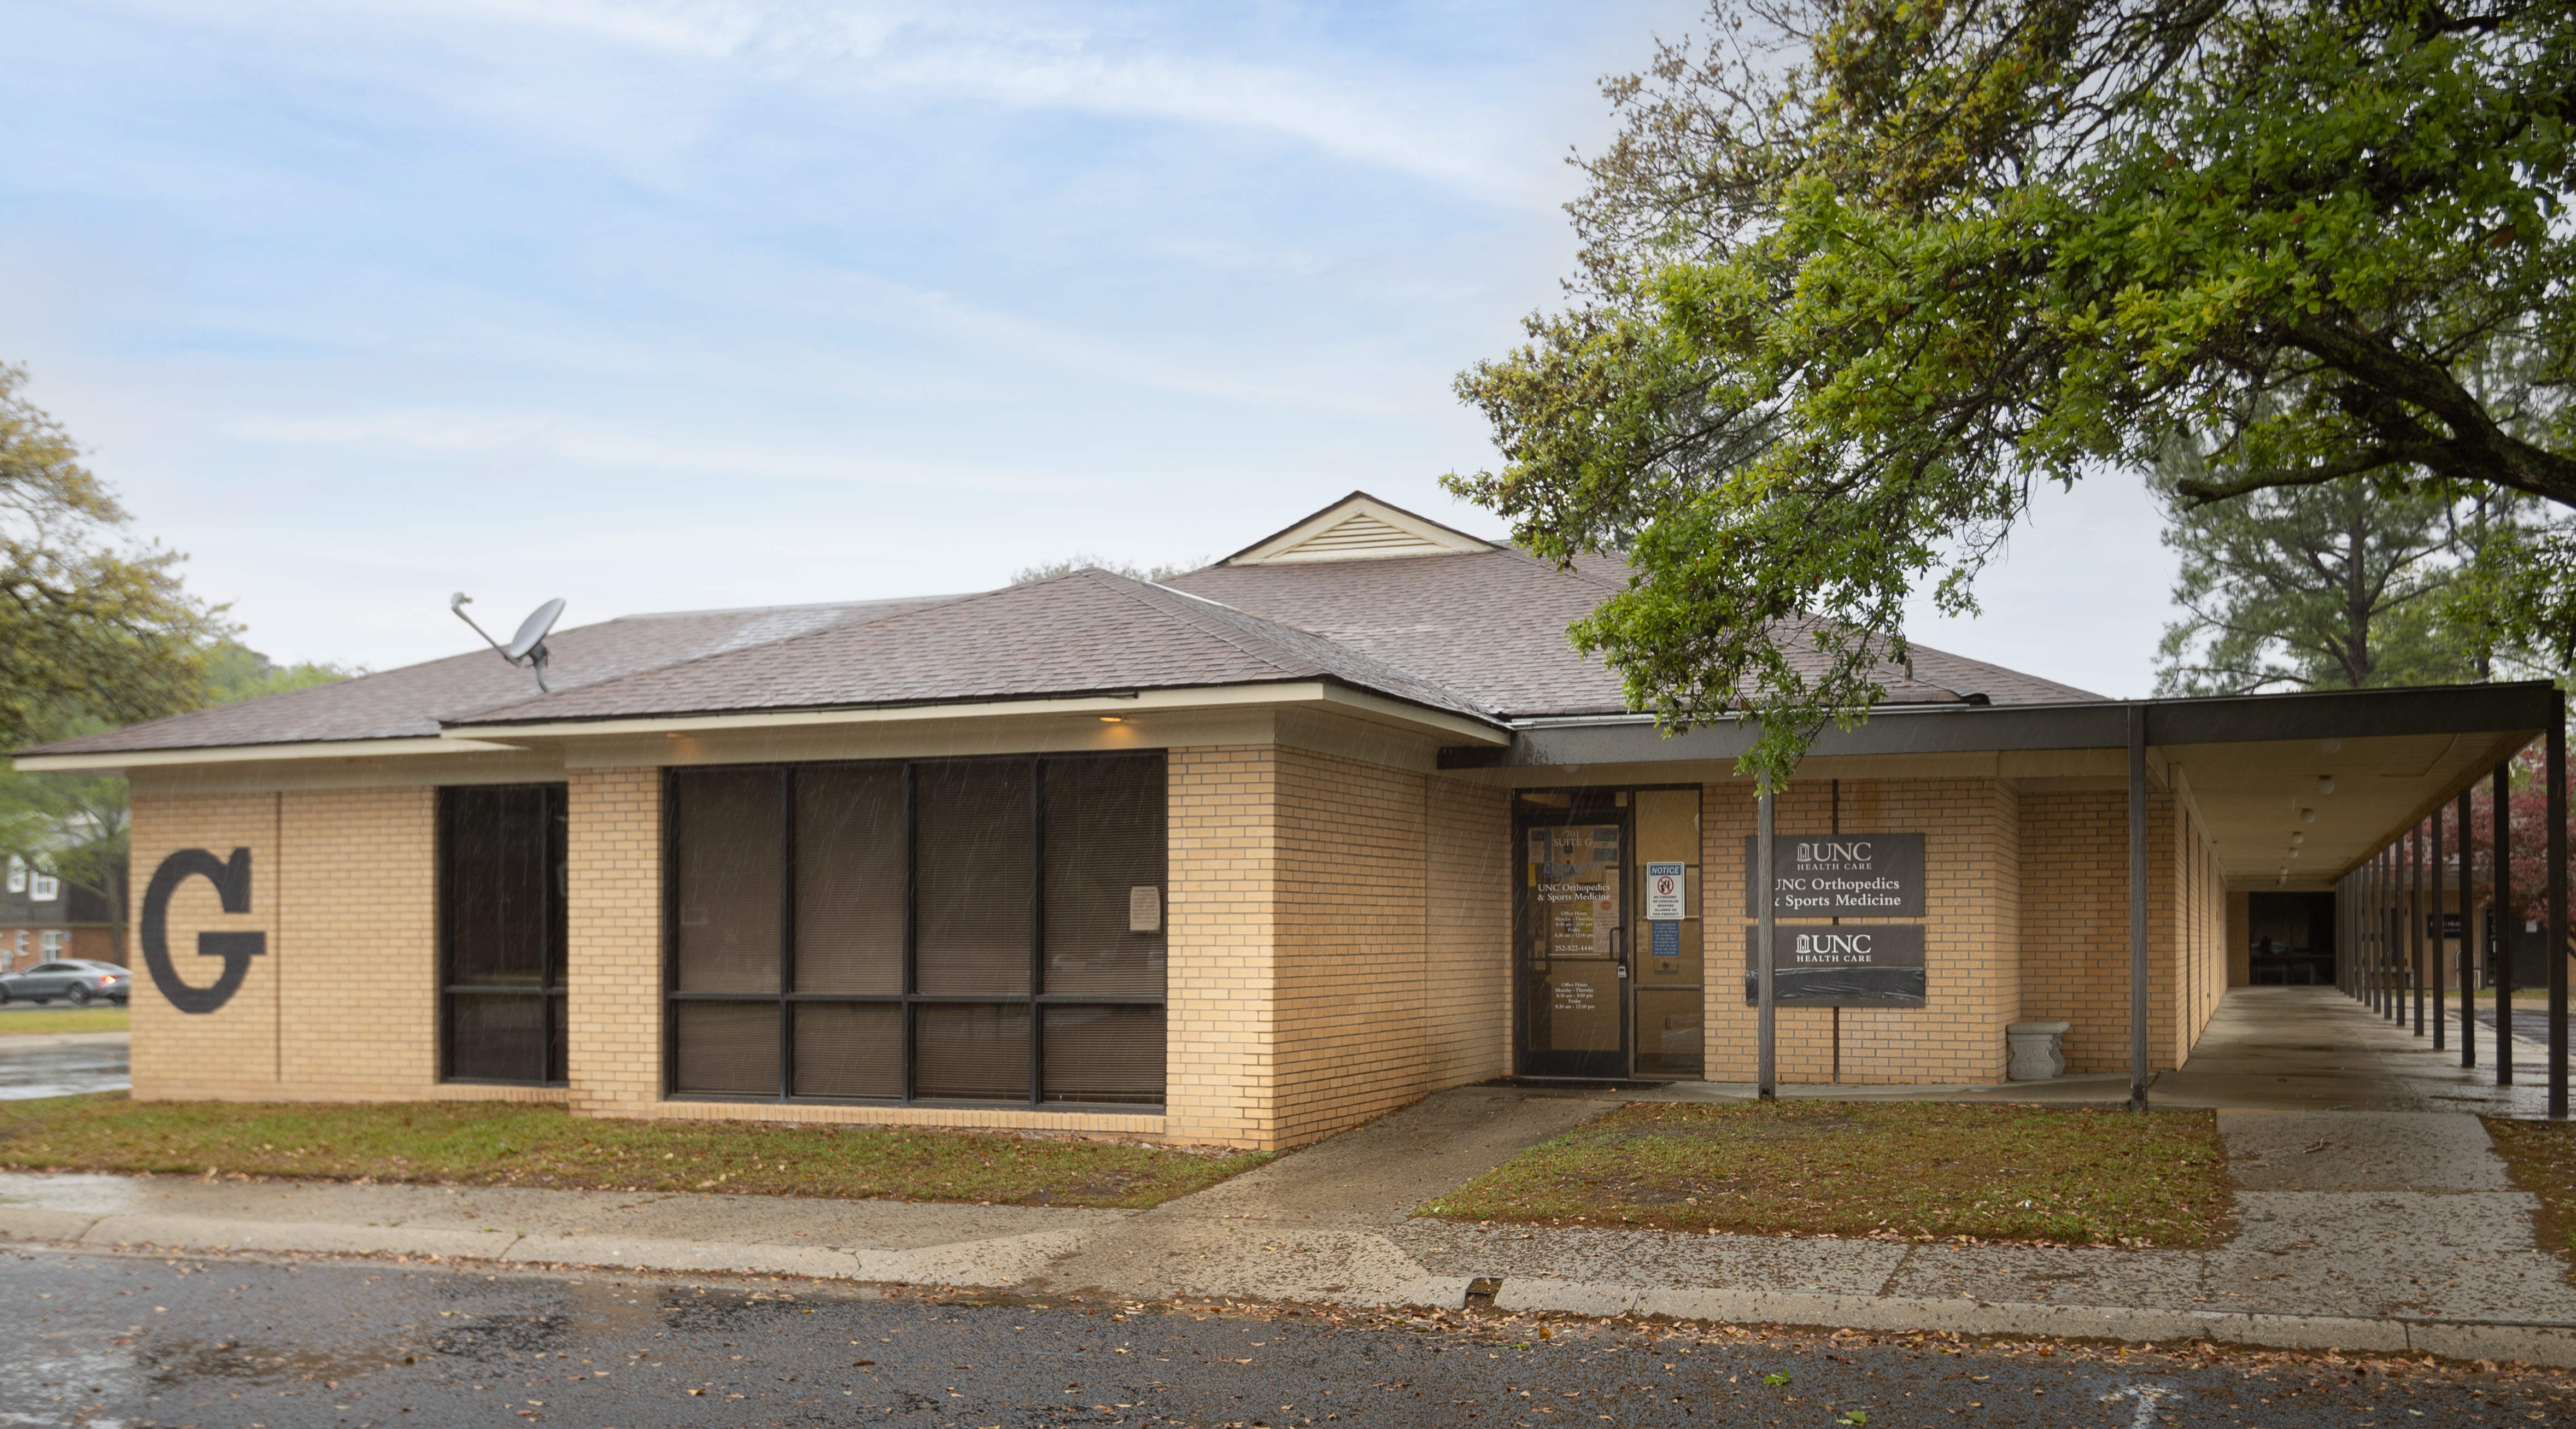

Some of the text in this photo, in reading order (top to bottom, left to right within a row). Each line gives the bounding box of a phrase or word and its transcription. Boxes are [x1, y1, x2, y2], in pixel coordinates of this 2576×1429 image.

[1812, 842, 1871, 862] UNC
[1562, 883, 1610, 893] Orthopedics
[1812, 877, 1900, 893] Orthopedics
[1547, 893, 1572, 903] Sports
[1574, 893, 1611, 901] Medicine
[1785, 894, 1830, 910] Sports
[1835, 893, 1901, 906] Medicine
[141, 847, 267, 1014] G
[1811, 934, 1871, 953] UNC
